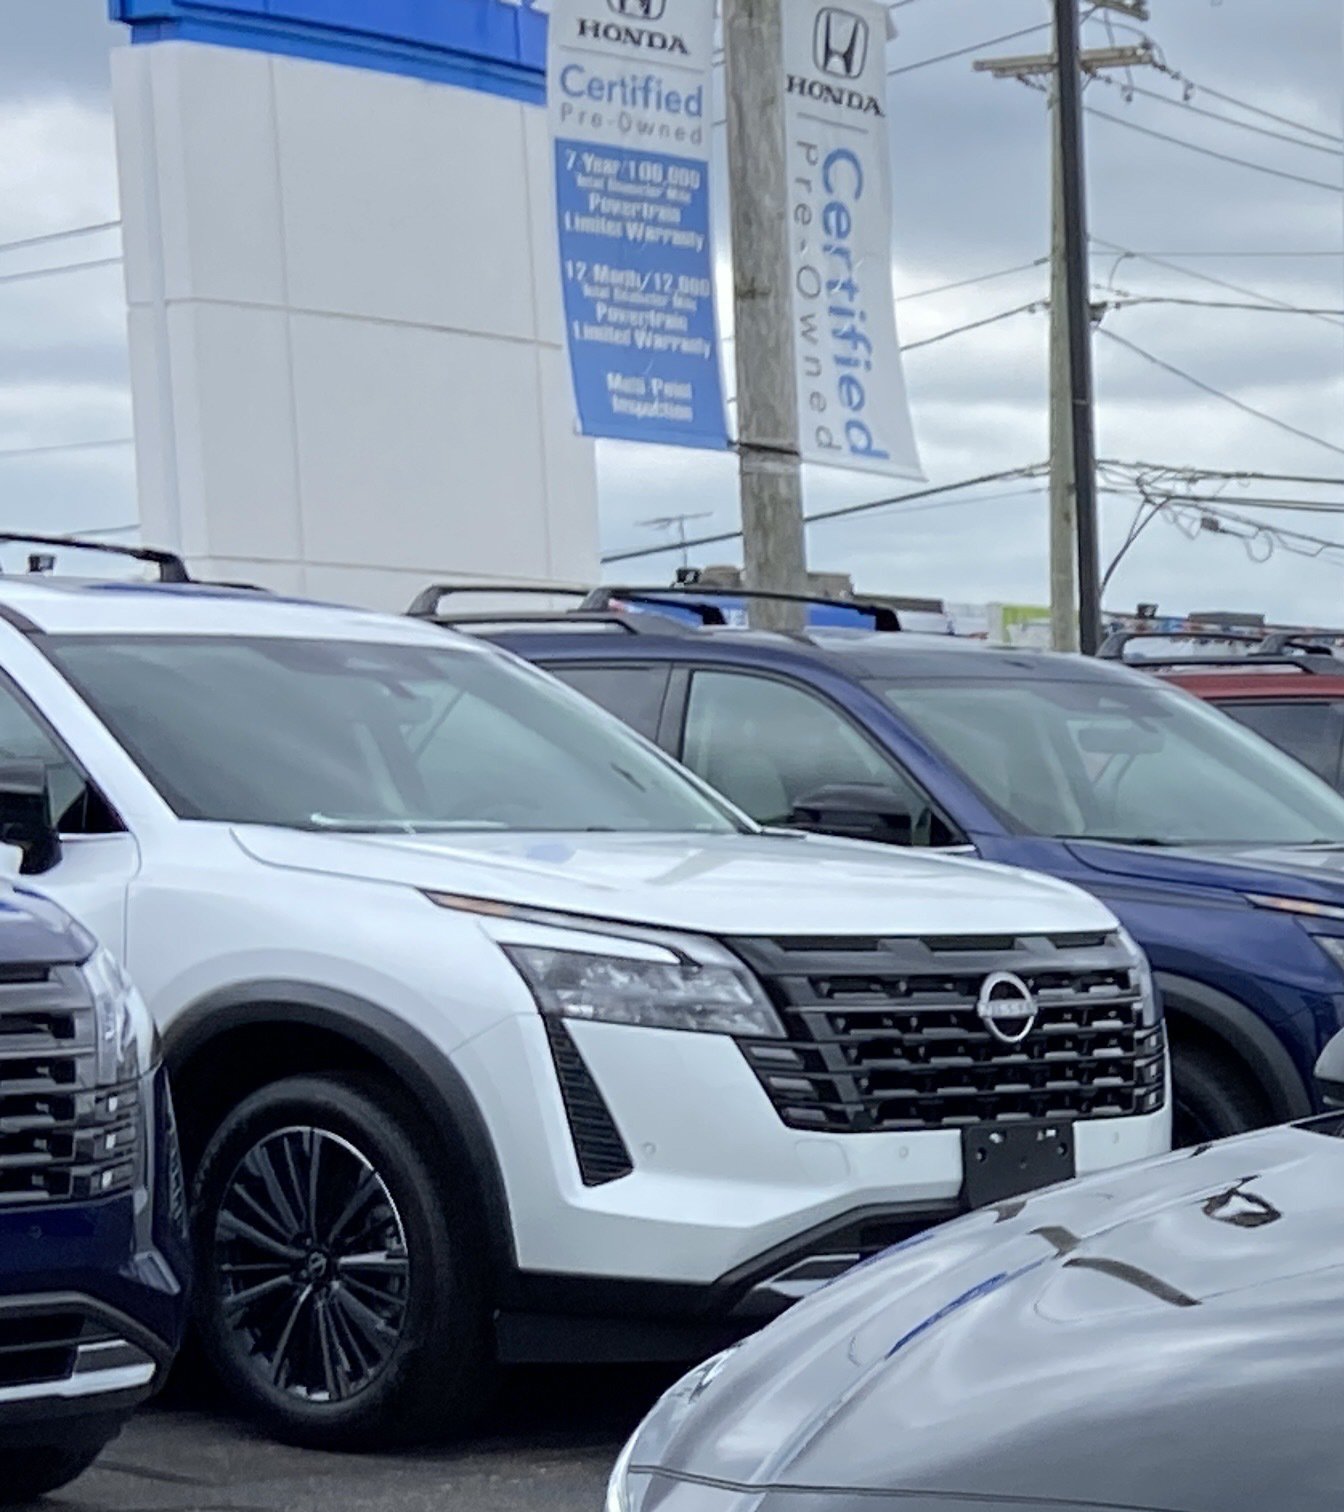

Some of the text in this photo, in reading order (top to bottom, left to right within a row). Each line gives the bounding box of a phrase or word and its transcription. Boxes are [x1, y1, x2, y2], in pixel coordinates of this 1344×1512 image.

[577, 18, 690, 54] HONDA
[560, 64, 703, 118] Certified
[786, 74, 886, 118] HONDA
[560, 102, 703, 145] Pre-Owned
[822, 148, 890, 460] Certified
